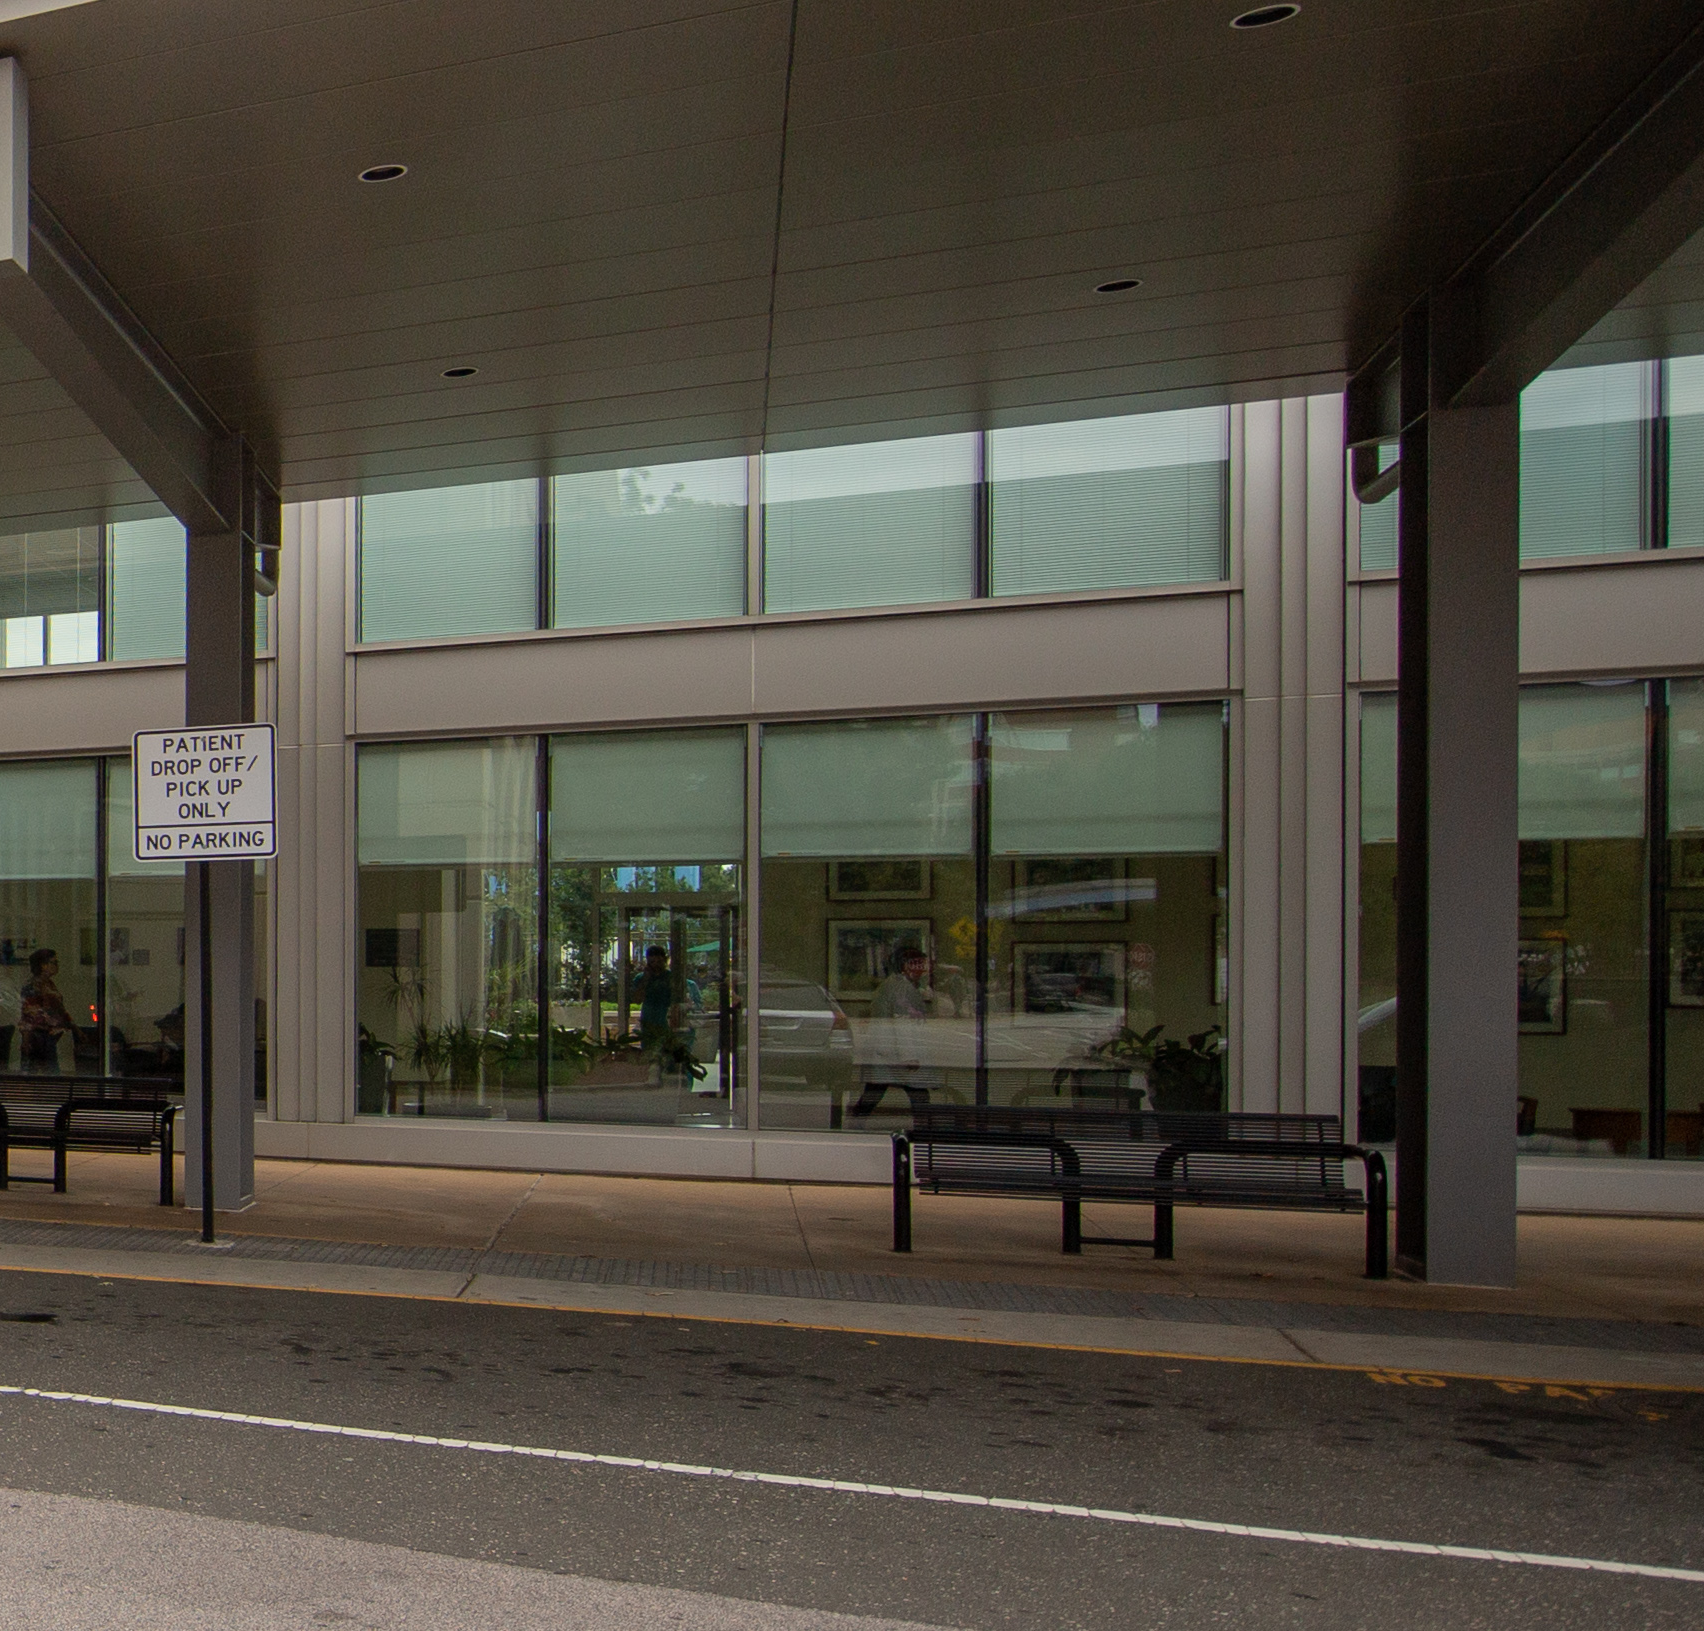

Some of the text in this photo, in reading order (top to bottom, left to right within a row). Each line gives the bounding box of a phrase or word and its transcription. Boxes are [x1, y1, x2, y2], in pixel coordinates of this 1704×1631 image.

[162, 734, 245, 754] PATIENT
[151, 755, 258, 776] DROP OFF/
[166, 779, 243, 797] PICK UP
[178, 801, 231, 819] ONLY
[146, 830, 265, 850] NO PARKING
